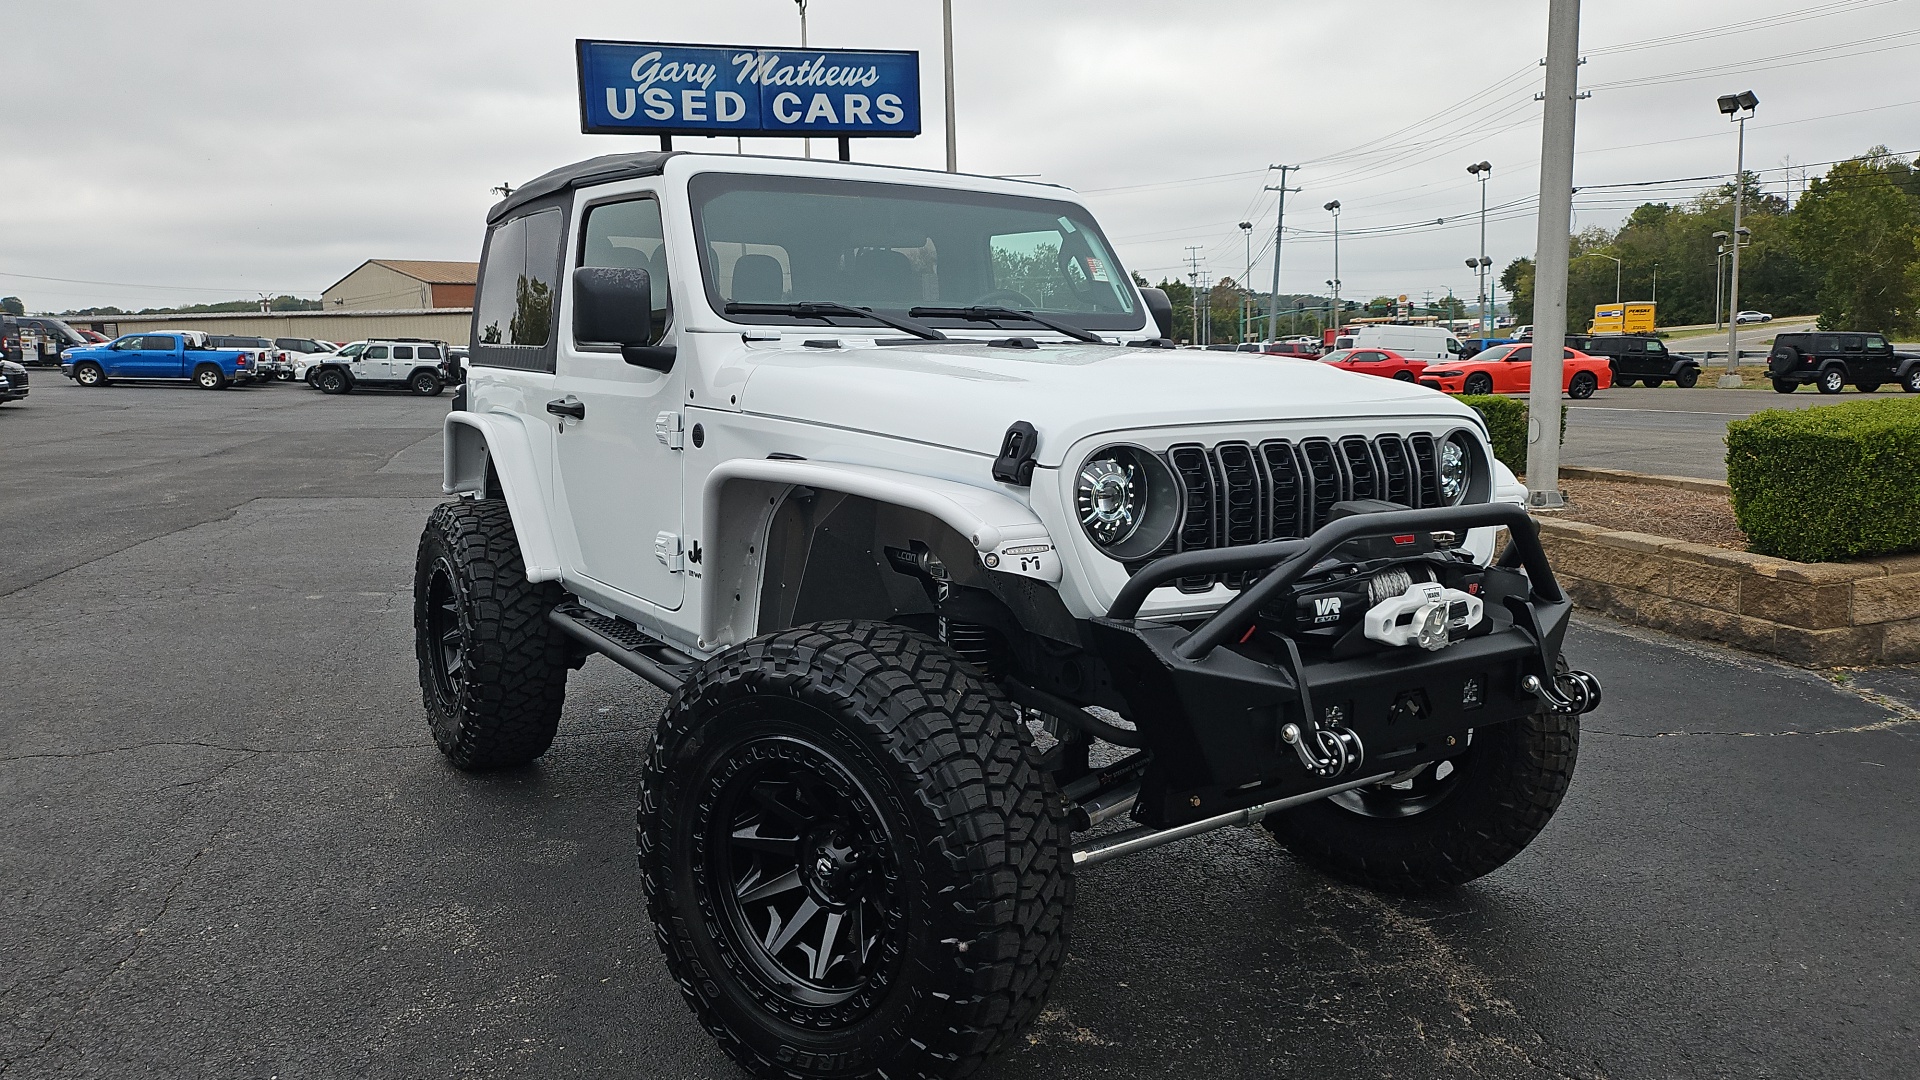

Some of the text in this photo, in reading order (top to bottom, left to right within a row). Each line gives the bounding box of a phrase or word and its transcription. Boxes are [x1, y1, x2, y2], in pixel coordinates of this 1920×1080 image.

[631, 51, 880, 94] Gary Mathews
[606, 88, 905, 125] USED CARS
[1468, 583, 1479, 595] 10
[1314, 597, 1342, 616] VR
[1314, 614, 1340, 624] EVO
